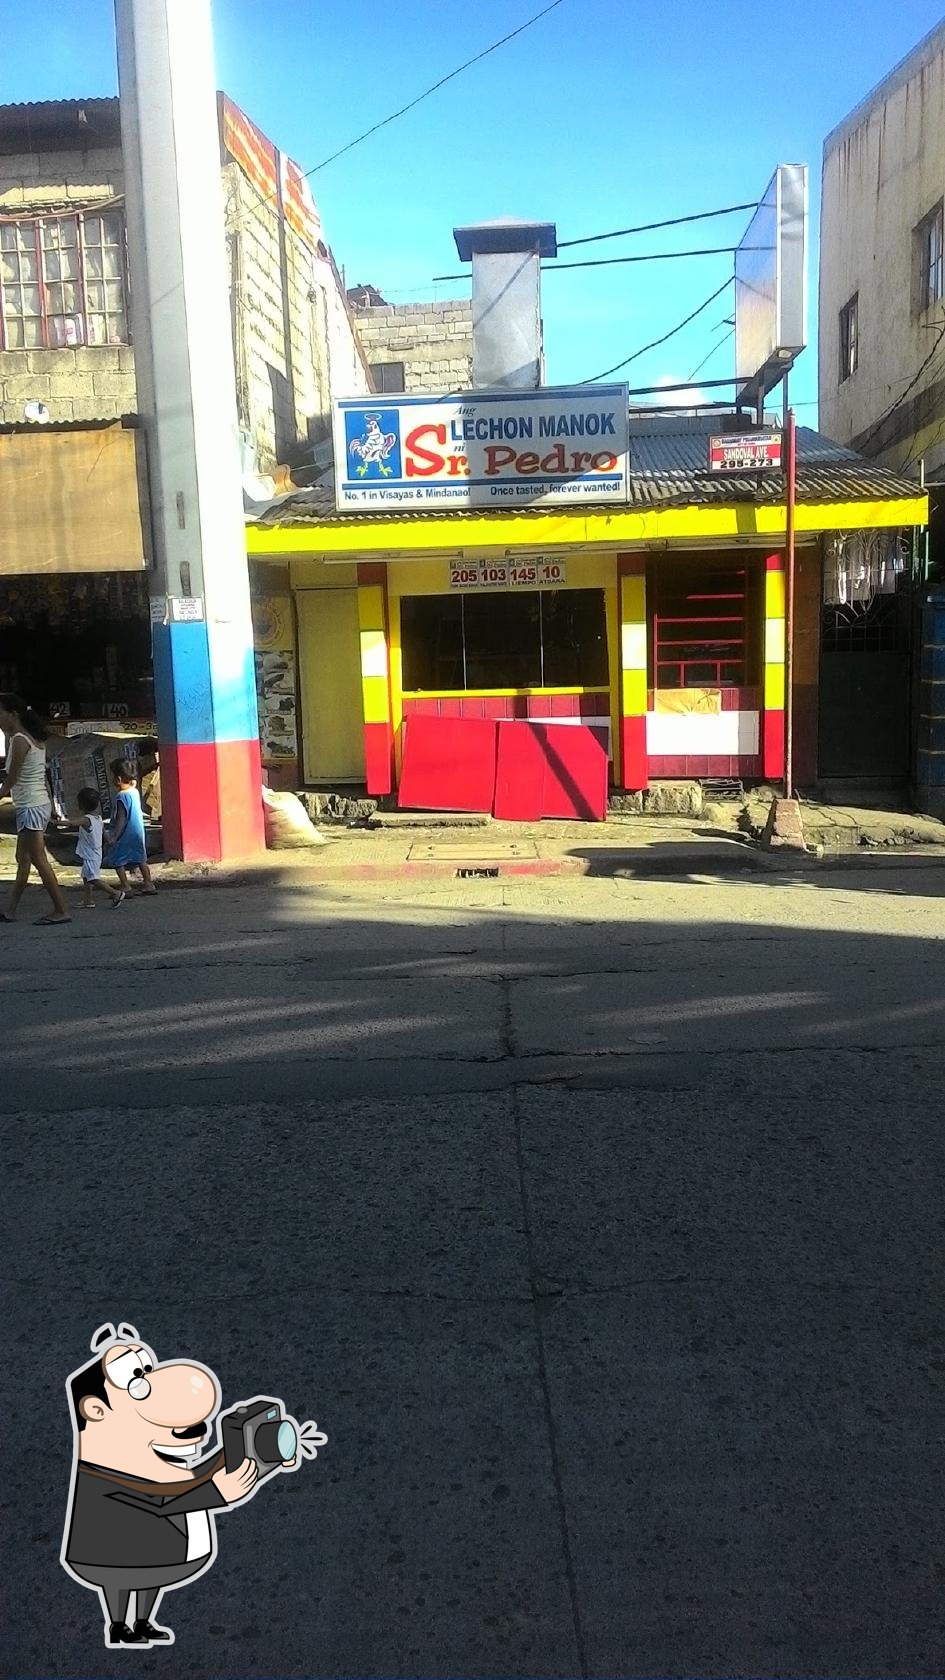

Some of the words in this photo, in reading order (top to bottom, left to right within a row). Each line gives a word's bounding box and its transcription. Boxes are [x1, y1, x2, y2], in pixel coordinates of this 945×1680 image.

[454, 406, 477, 417] Ang
[451, 416, 533, 441] LECHON
[539, 412, 616, 438] MANOK
[405, 424, 471, 477] Sr.
[484, 444, 618, 474] Pedro
[453, 442, 466, 452] ni
[724, 446, 754, 459] SANDOVAL
[721, 459, 772, 468] 295-273
[344, 491, 359, 500] No.
[362, 491, 367, 500] 1
[369, 491, 378, 500] in
[379, 489, 414, 501] Visayas
[416, 489, 424, 498] &
[425, 487, 471, 498] Mindanao!
[490, 486, 514, 496] Once
[516, 484, 548, 496] tasted,
[549, 483, 581, 493] forever
[583, 481, 620, 493] wanted!
[451, 570, 478, 583] 205
[481, 569, 507, 581] 103
[510, 568, 536, 580] 145
[542, 565, 561, 579] 10
